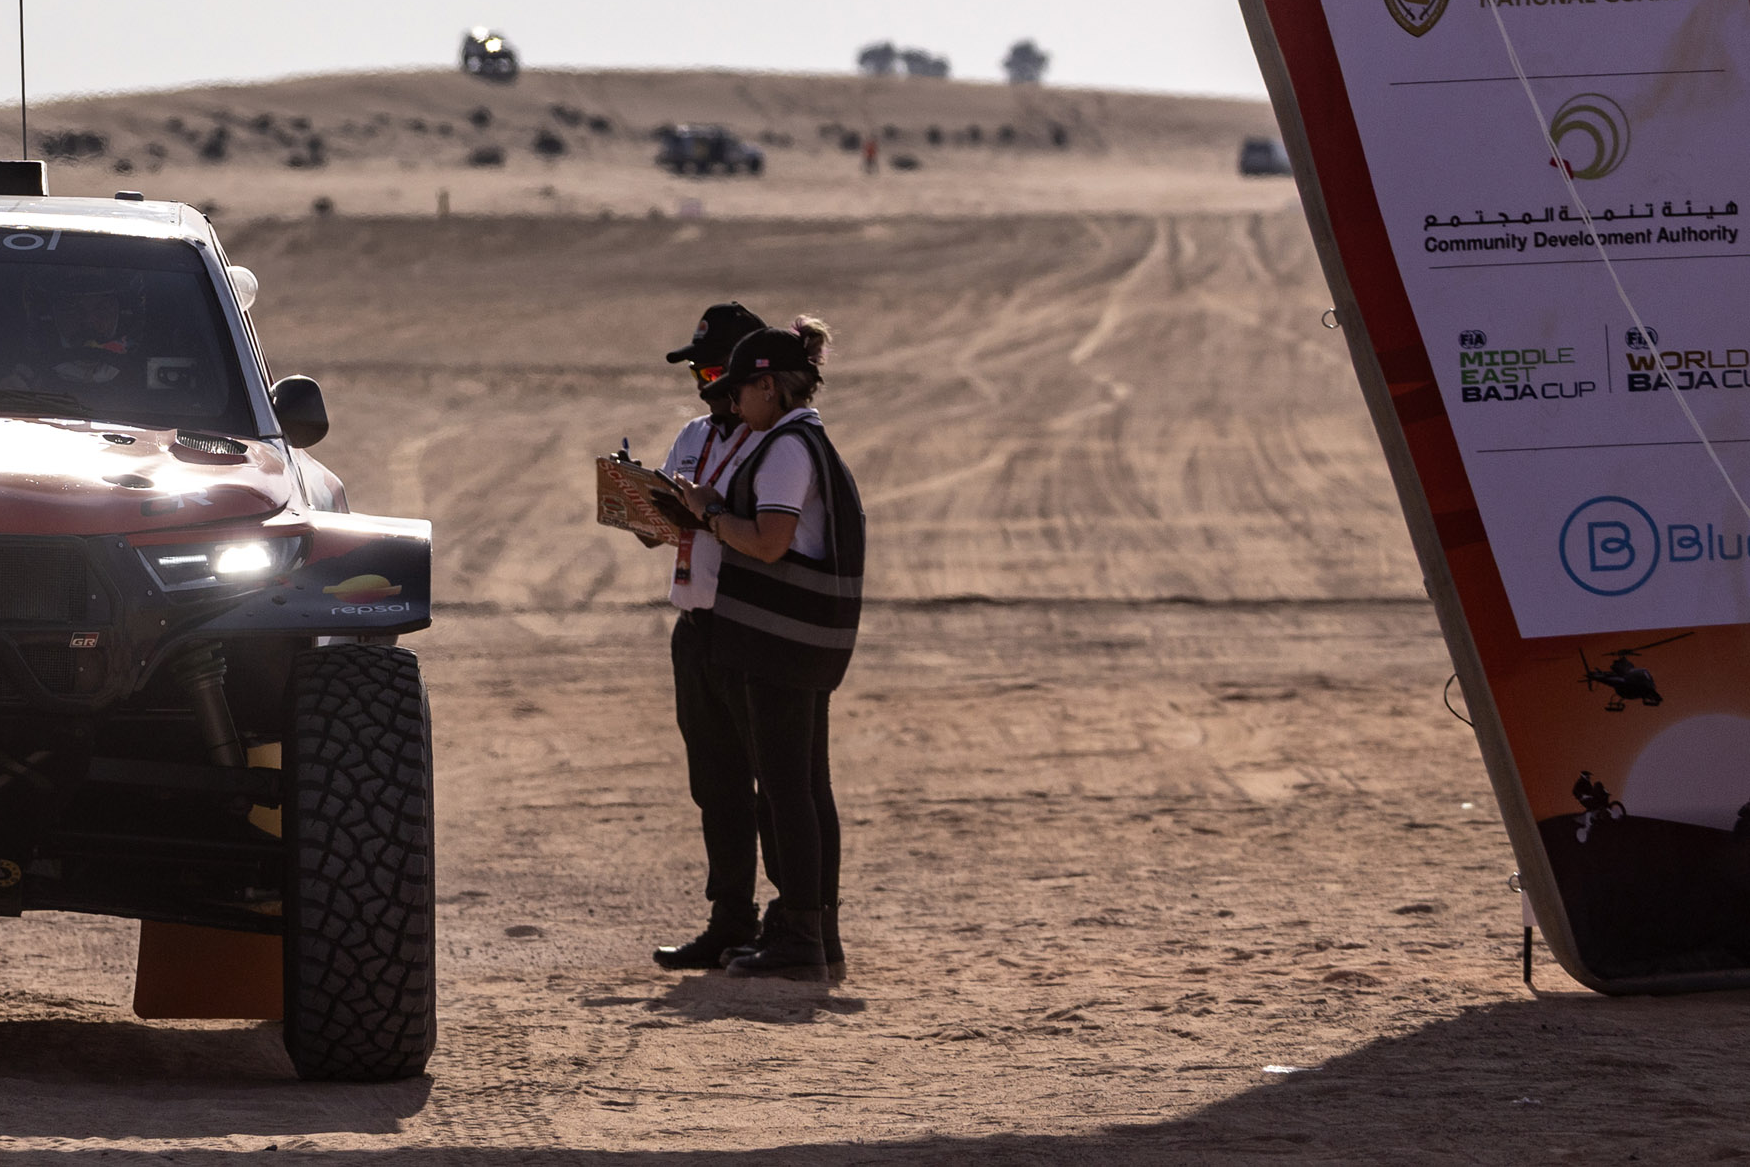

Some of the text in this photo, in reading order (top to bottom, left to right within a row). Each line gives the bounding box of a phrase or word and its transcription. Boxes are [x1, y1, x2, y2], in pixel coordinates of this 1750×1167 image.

[1424, 207, 1554, 233] المجتمع
[1425, 225, 1738, 252] Community Development Authority
[1460, 347, 1574, 367] MIDDLE
[1626, 349, 1750, 371] WORLD
[1460, 366, 1536, 385] EAST
[1628, 369, 1718, 392] BAJA
[1462, 381, 1596, 402] BAJA CUP
[1668, 524, 1750, 562] Blu
[330, 602, 412, 617] repsol
[72, 638, 95, 646] GR
